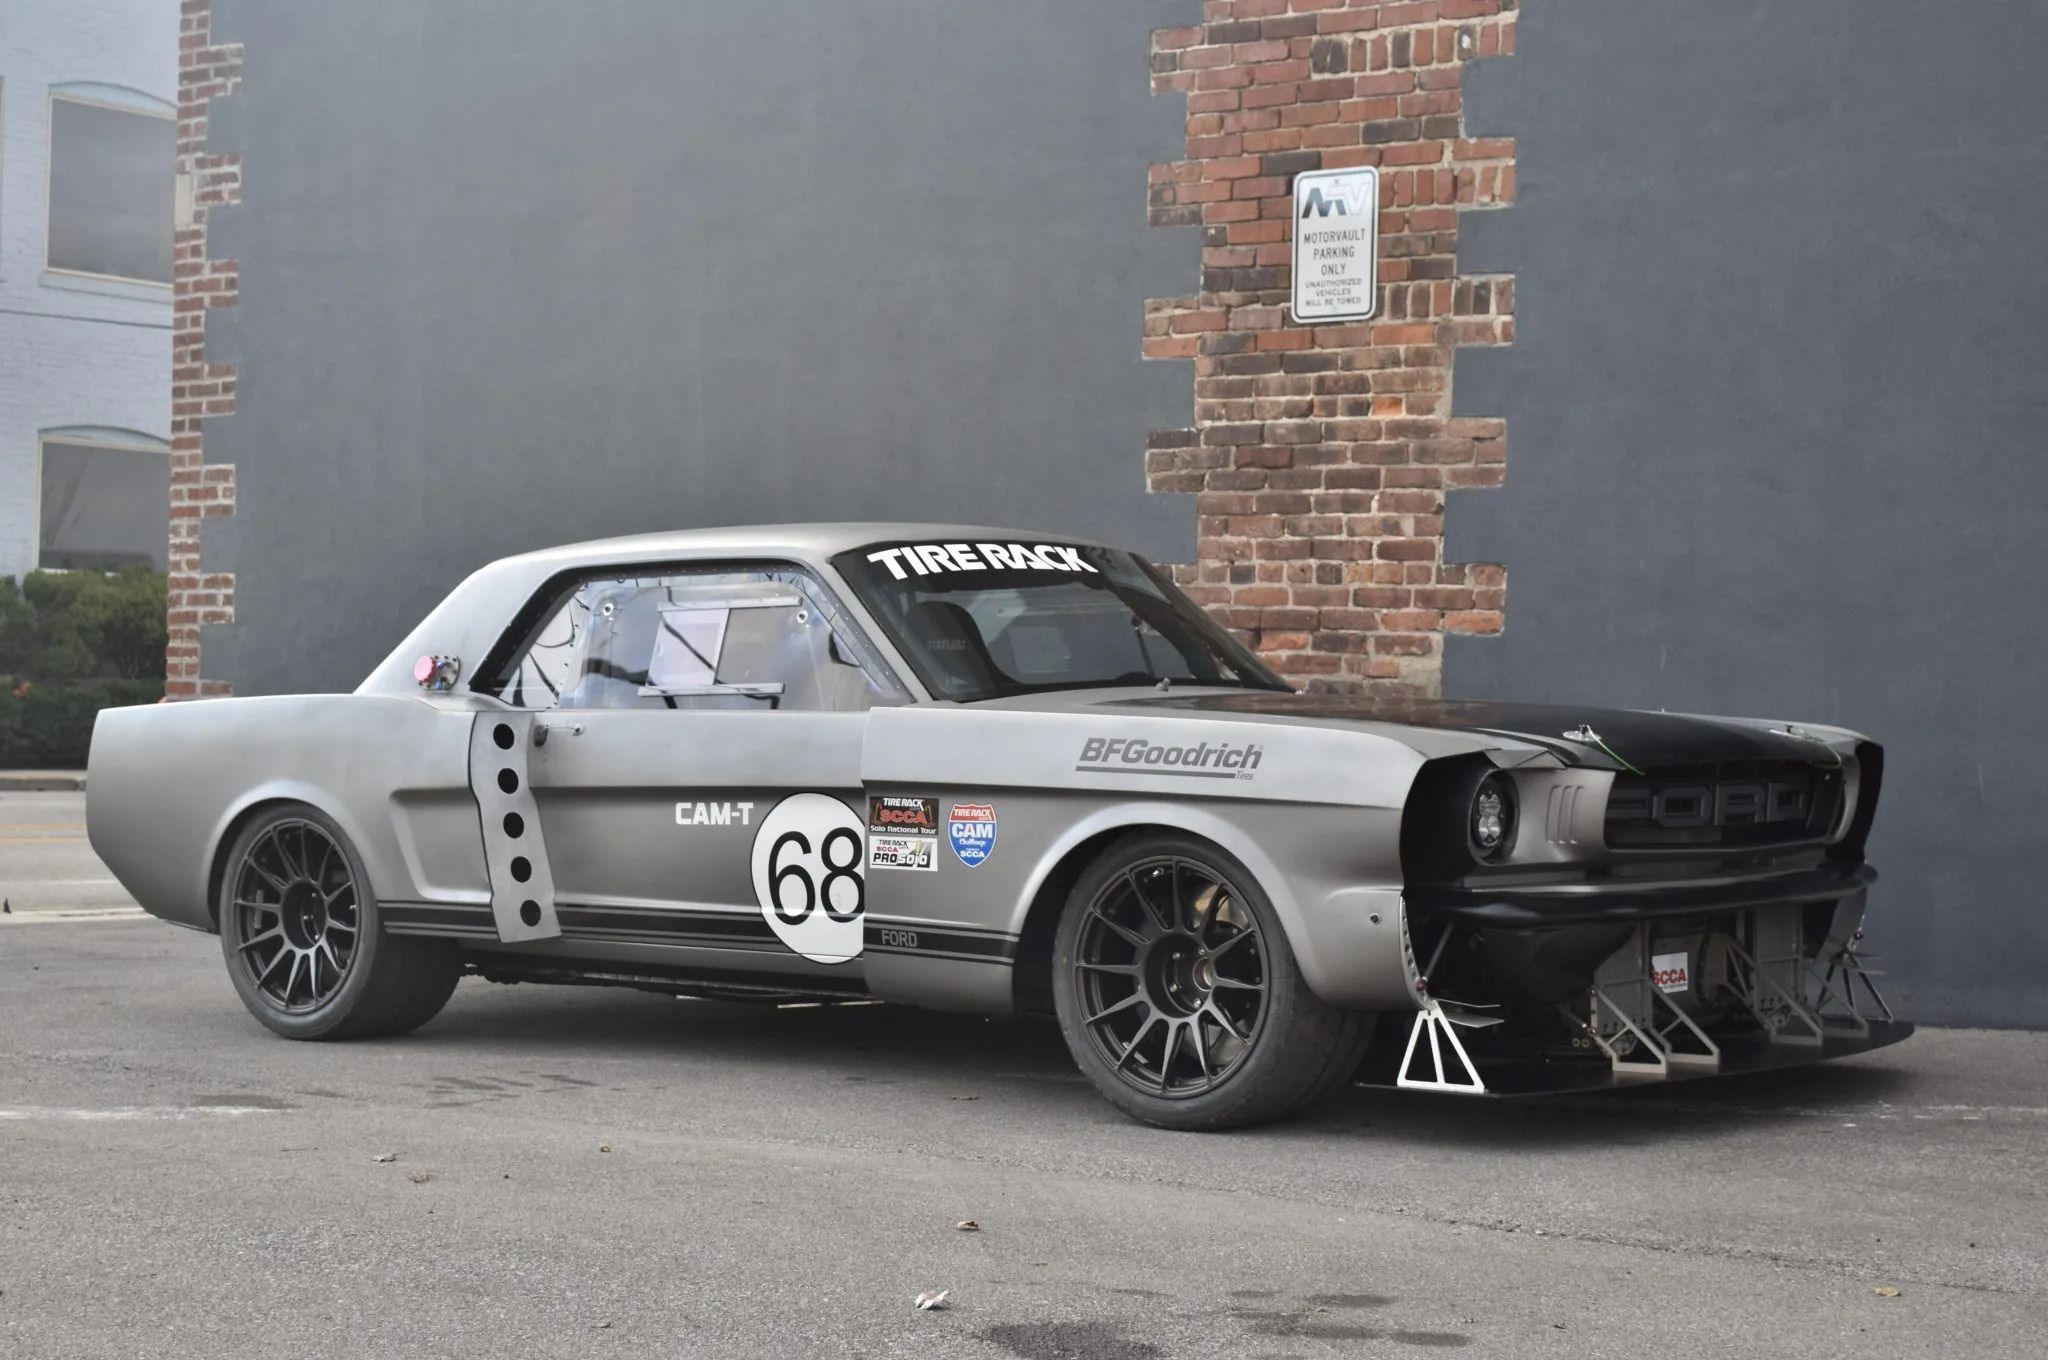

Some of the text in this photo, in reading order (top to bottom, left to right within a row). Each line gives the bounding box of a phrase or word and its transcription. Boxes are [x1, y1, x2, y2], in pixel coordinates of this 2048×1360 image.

[1304, 228, 1366, 244] MOTORVAULT
[1313, 246, 1355, 260] PARKING
[1321, 263, 1346, 276] ONLY
[1305, 278, 1363, 289] UNAUTHORIZED
[1316, 289, 1351, 297] VEHICLES
[866, 543, 1099, 580] TIRE RACK
[1079, 737, 1263, 769] BFGoodrich
[1235, 770, 1254, 781] Tires
[883, 798, 924, 811] TIRE RACK
[675, 802, 754, 825] CAM-T
[880, 809, 927, 824] SCCA
[970, 810, 992, 820] RACK
[887, 826, 918, 834] National
[951, 823, 993, 838] CAM
[892, 840, 909, 849] RACK
[960, 850, 985, 858] SCCA
[768, 827, 865, 926] 68
[881, 929, 918, 948] FORD
[1651, 967, 1687, 985] SCCA
